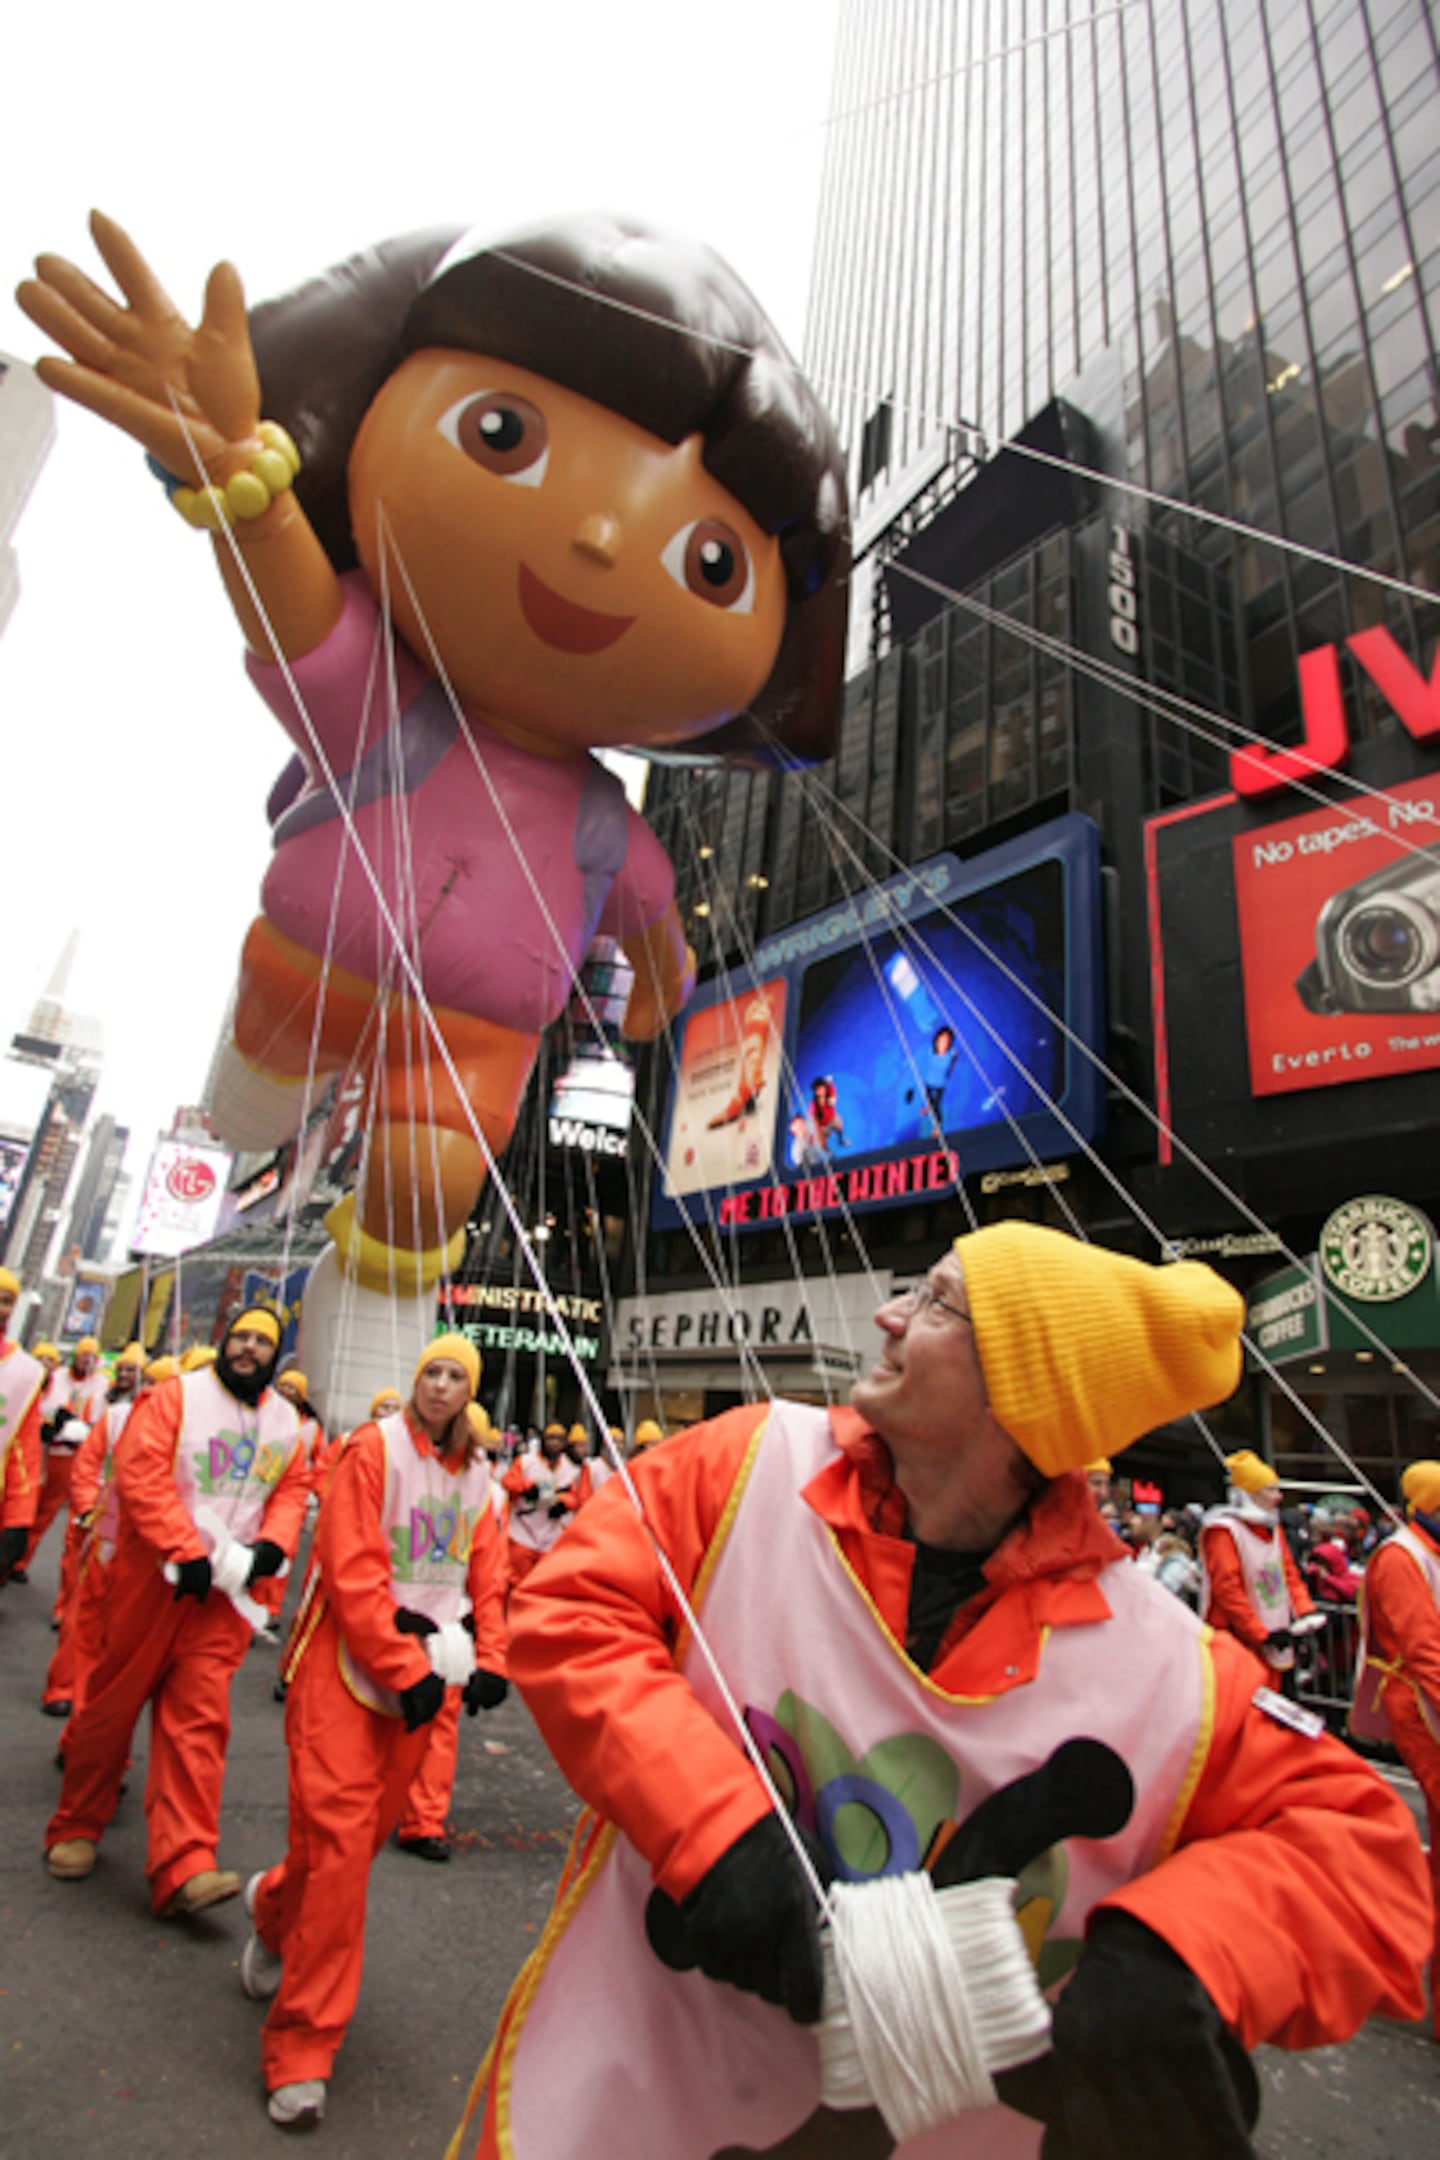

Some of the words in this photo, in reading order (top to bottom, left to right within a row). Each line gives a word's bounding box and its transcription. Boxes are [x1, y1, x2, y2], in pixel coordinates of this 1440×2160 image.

[1109, 524, 1139, 656] 1500
[1253, 840, 1294, 869] No
[1388, 800, 1435, 828] No
[628, 1304, 814, 1349] SEPHORA
